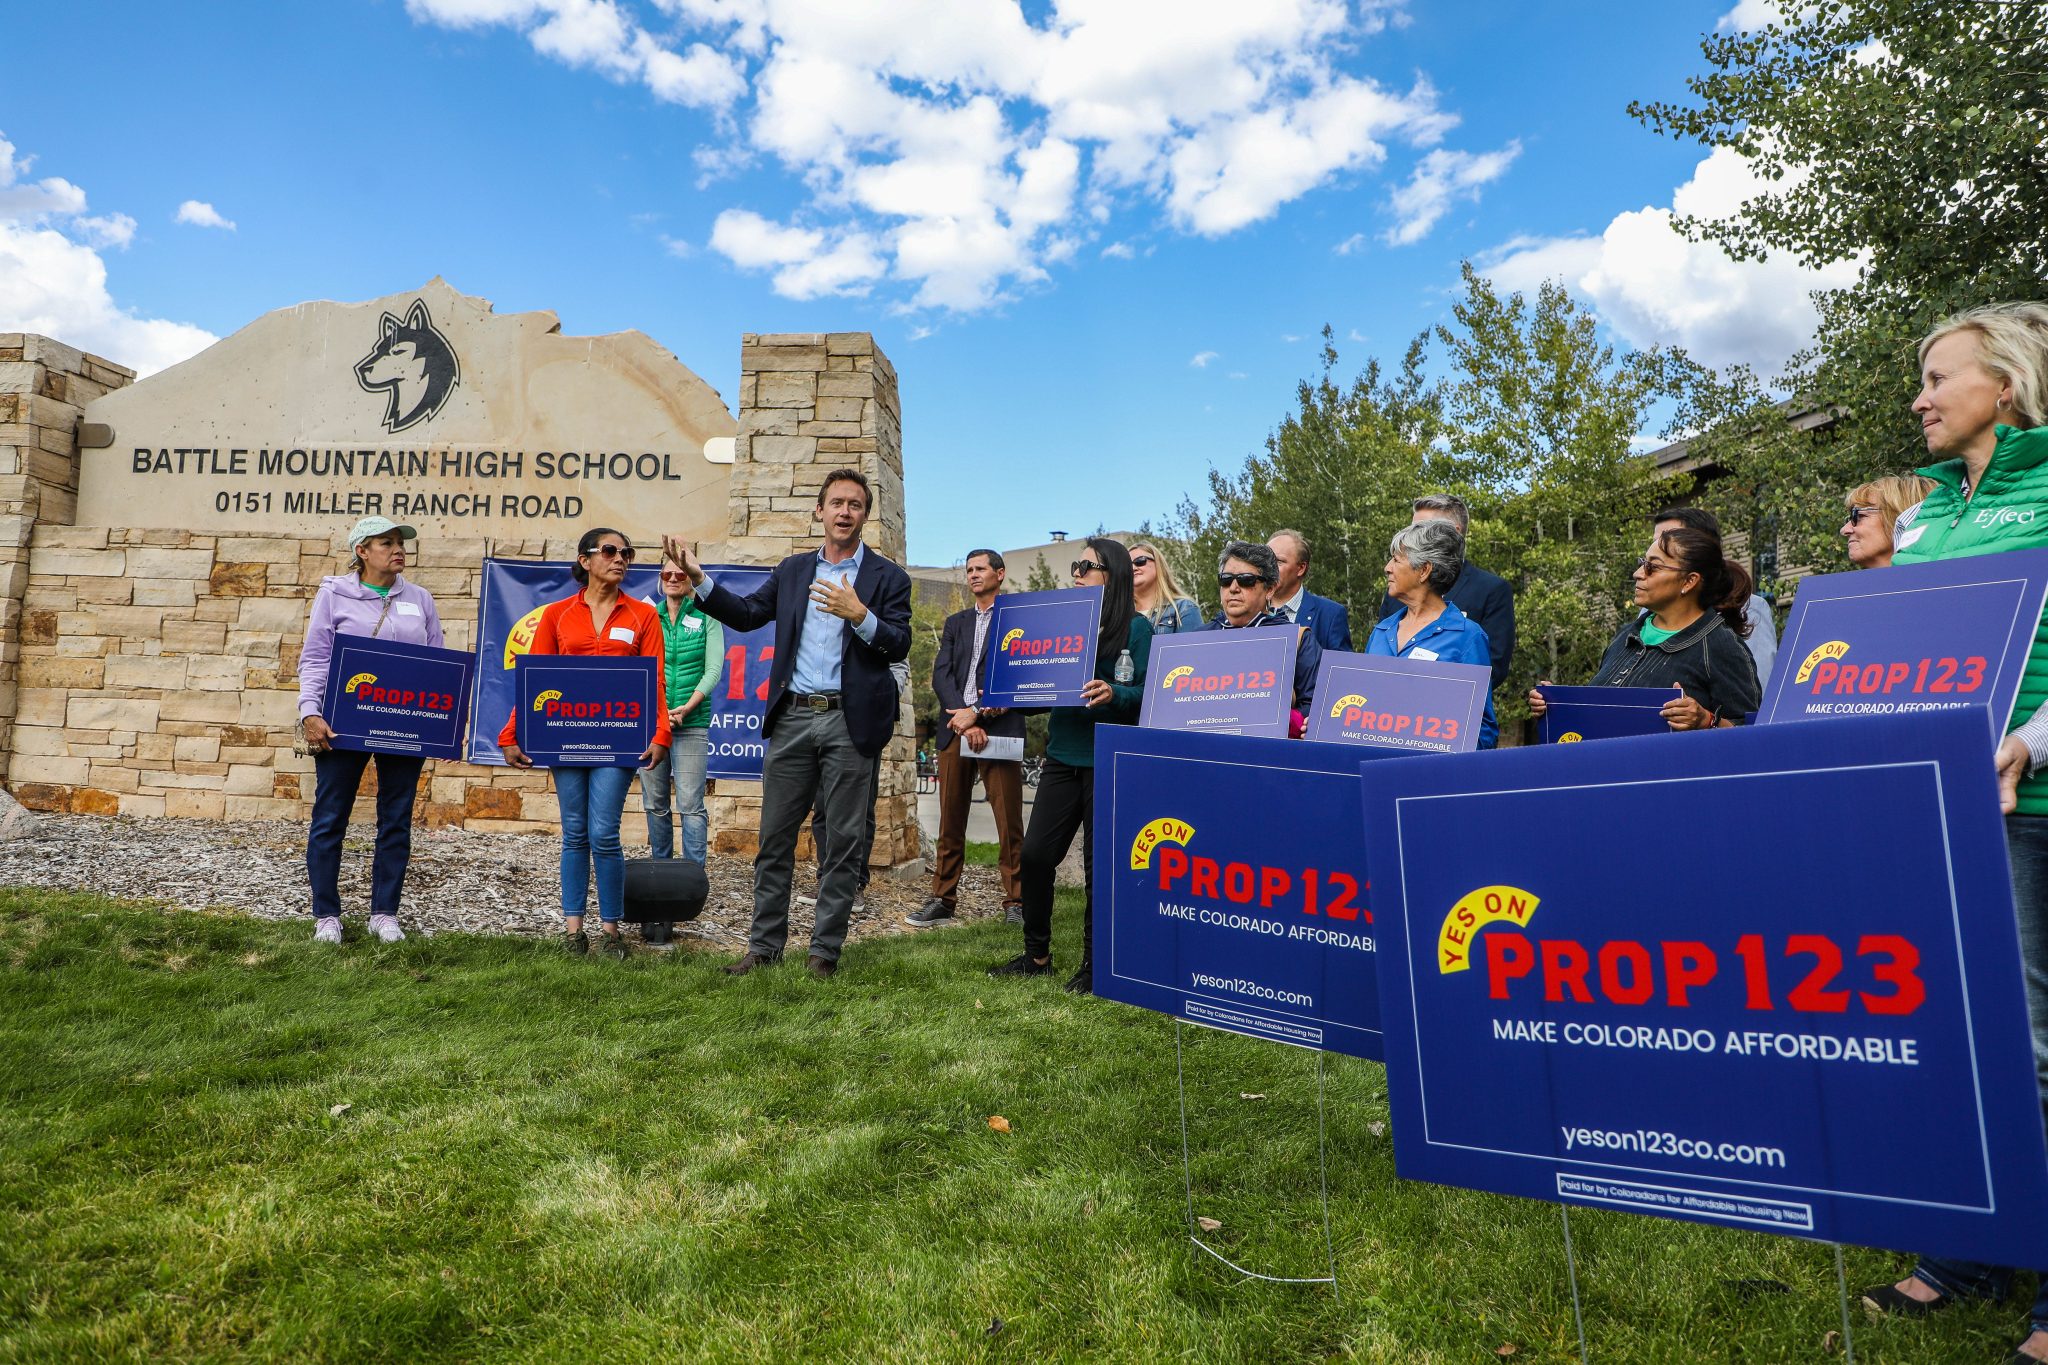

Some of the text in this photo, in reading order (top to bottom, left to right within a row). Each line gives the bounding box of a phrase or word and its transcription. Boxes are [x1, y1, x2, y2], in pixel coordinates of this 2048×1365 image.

[132, 448, 681, 481] BATTLE MOUNTAIN HIGH SCHOOL
[215, 491, 583, 519] 0151 MILLER RANCH ROAD
[1009, 635, 1085, 656] PROP 123
[1022, 658, 1048, 666] COLORADO
[1049, 656, 1080, 664] AFFORDABLE
[1798, 644, 1845, 681] YES ON
[1811, 656, 1988, 694] PROP 123
[348, 674, 375, 692] YES ON
[1164, 671, 1177, 687] YES
[1175, 671, 1276, 694] PROP 123
[358, 683, 454, 711] PROP 123
[536, 691, 559, 710] YES ON
[546, 701, 641, 719] PROP 123
[1174, 691, 1271, 703] MAKE COLORADO AFFORDABLE
[1332, 696, 1364, 716] YES ON
[1805, 703, 1833, 714] MAKE
[1834, 703, 1895, 714] COLORADO
[356, 704, 449, 720] MAKE COLORADO AFFORDABLE
[709, 713, 765, 729] AFFO
[1344, 707, 1459, 740] PROP 123
[1342, 730, 1452, 752] MAKE COLORADO AFFORDABLE
[1134, 822, 1188, 866] YES ON
[1158, 846, 1374, 924] PROP 12
[1158, 901, 1196, 922] MAKE
[1199, 909, 1284, 936] COLORADO
[1444, 892, 1527, 967] YES ON
[1483, 932, 1927, 1016] PROP 123
[1191, 971, 1313, 1007] yeson123co.com
[1187, 1004, 1199, 1012] Paid
[1207, 1008, 1214, 1017] by
[1245, 1017, 1254, 1025] for
[1254, 1020, 1283, 1031] Affordable
[1283, 1026, 1307, 1038] Housing
[1307, 1030, 1320, 1039] Now
[1492, 1018, 1919, 1065] MAKE COLORADO AFFORDABLE
[1561, 1126, 1786, 1168] yeson123co.com
[1560, 1179, 1580, 1190] Paid
[1582, 1181, 1595, 1193] for
[1596, 1184, 1608, 1196] by
[1609, 1186, 1666, 1203] Coloradans
[1666, 1193, 1681, 1203] for
[1683, 1196, 1737, 1212] Affordable
[1737, 1203, 1782, 1220] Housing
